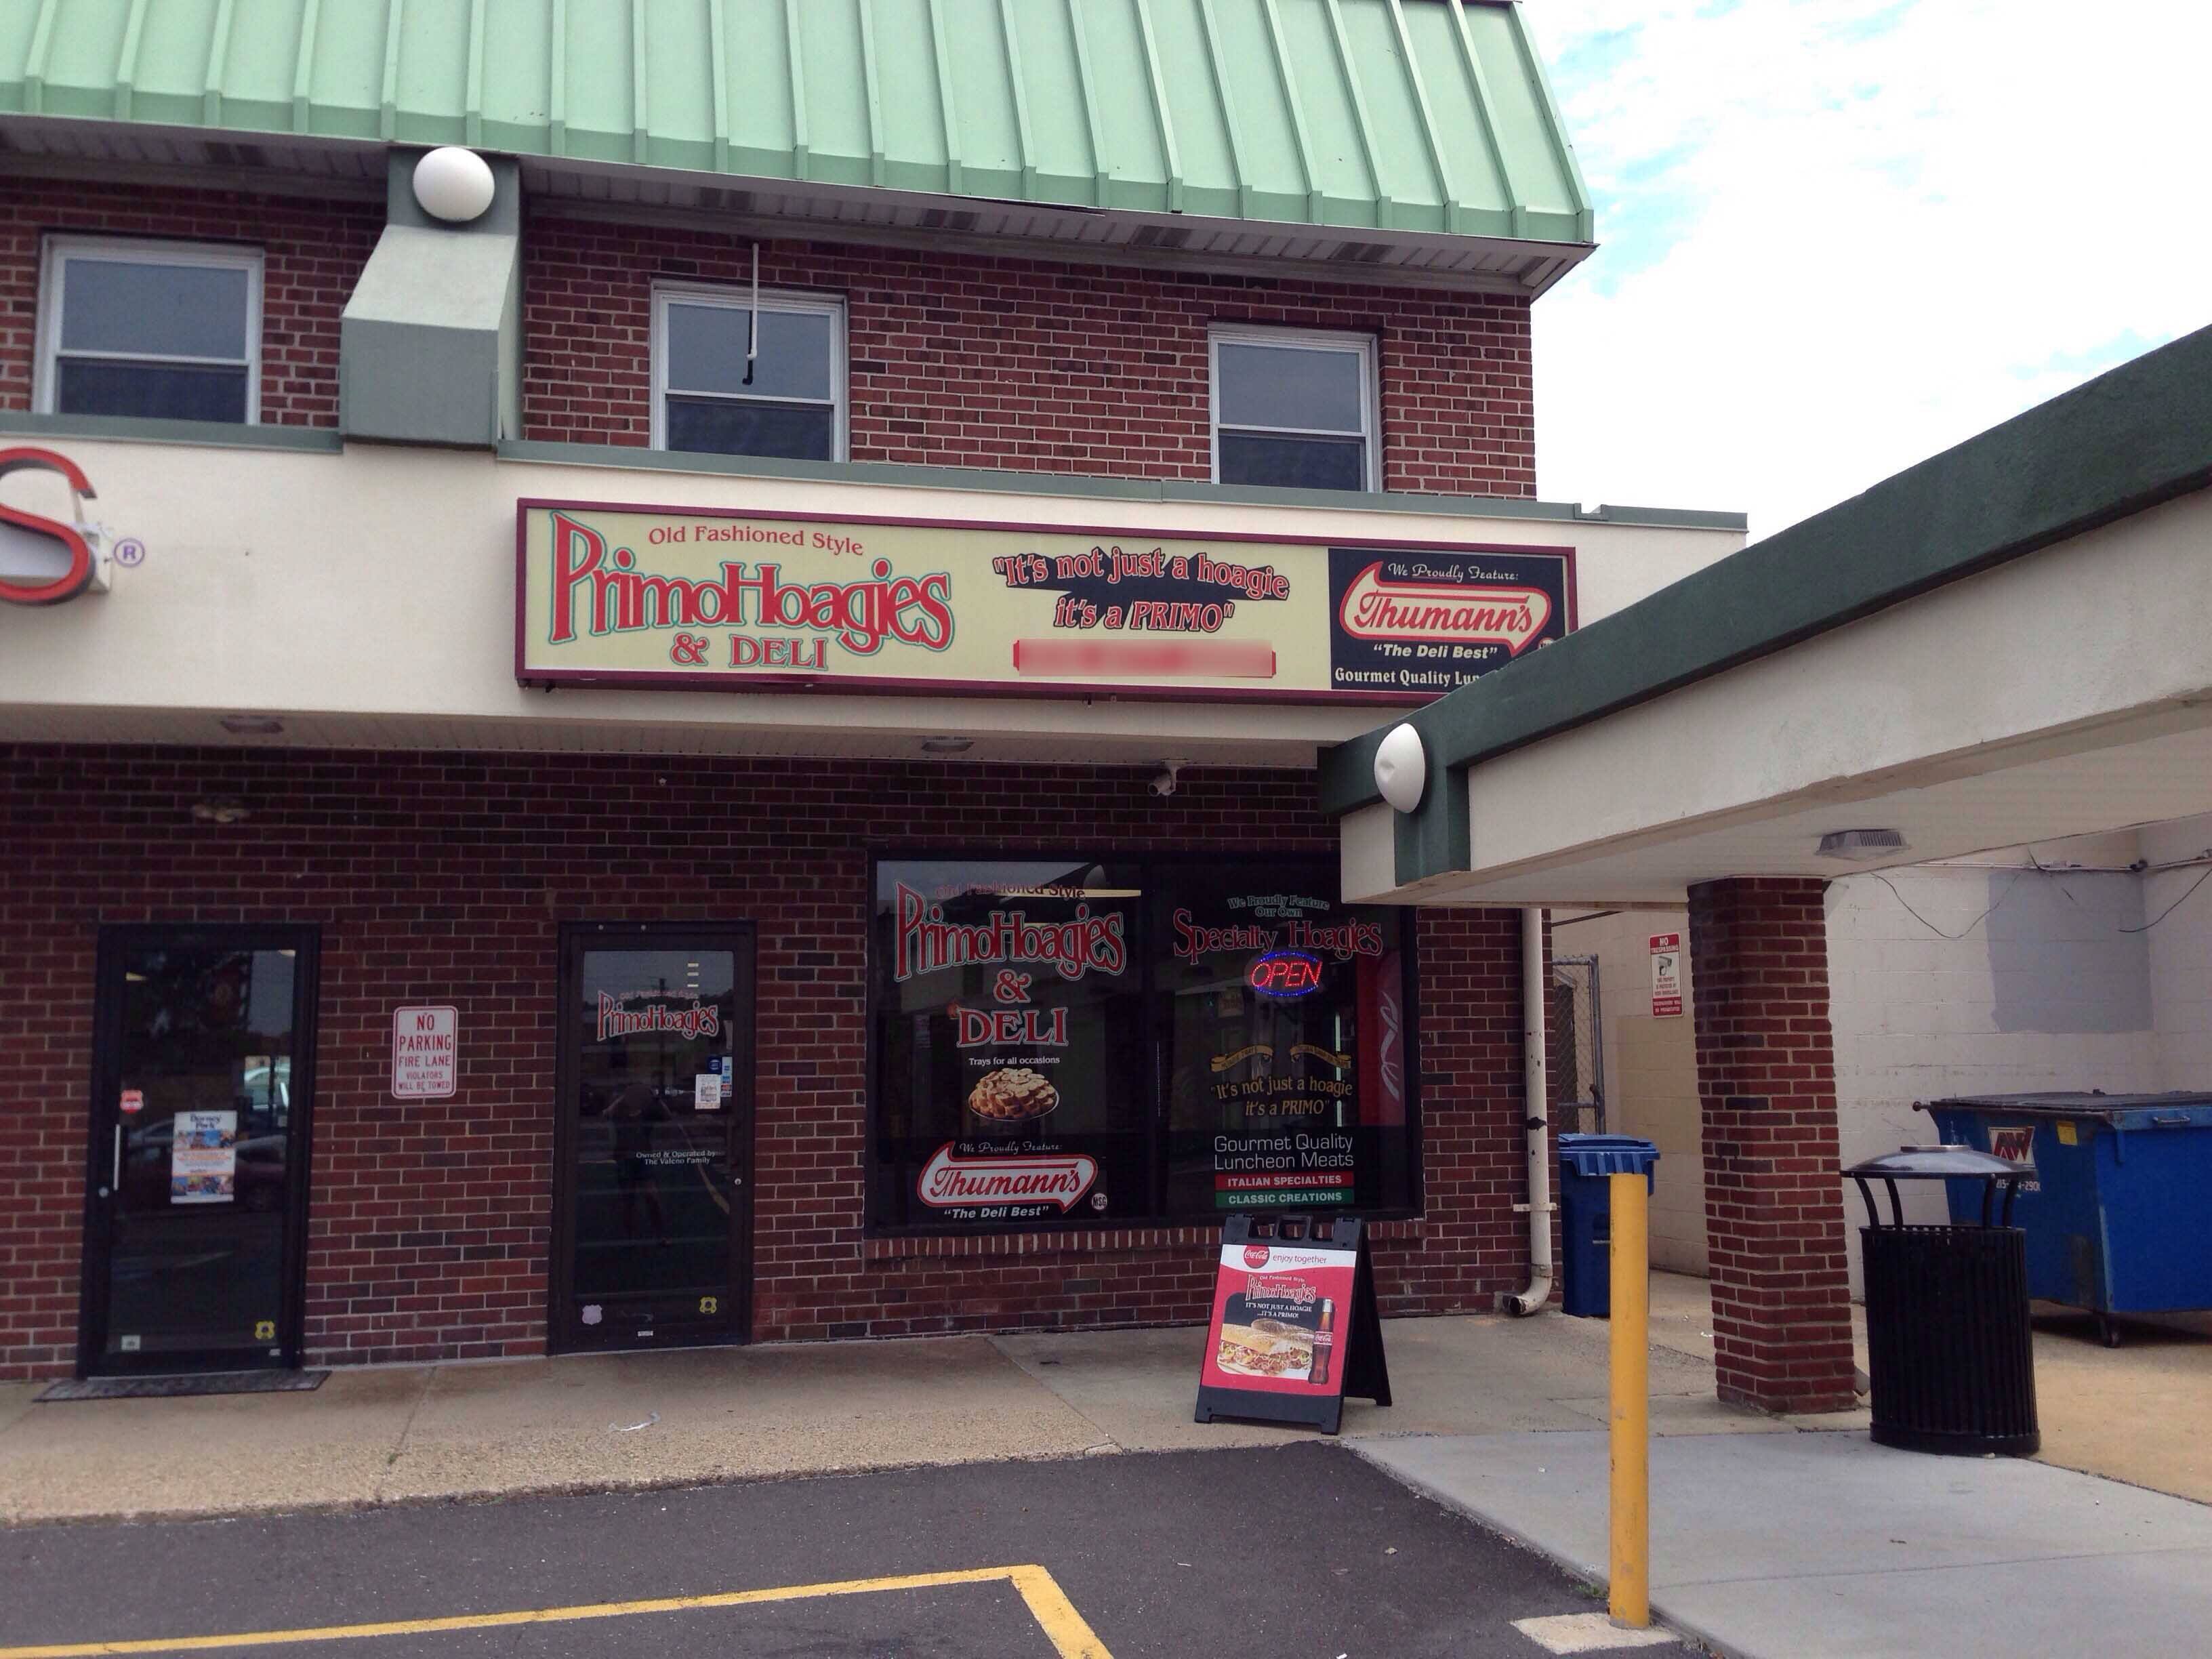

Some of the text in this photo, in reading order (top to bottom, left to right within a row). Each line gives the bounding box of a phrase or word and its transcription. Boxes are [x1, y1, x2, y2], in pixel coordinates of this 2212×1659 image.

[649, 525, 863, 556] Old Fashioned Style
[993, 546, 1290, 600] "It's not just a hoagie
[1388, 562, 1519, 583] We Proudly Feature:
[548, 511, 954, 656] PrimoHoagies
[1054, 597, 1235, 633] it's a PRIMO"
[1354, 591, 1532, 632] Thumann's
[670, 632, 829, 670] & DELI
[1374, 644, 1498, 659] "The Deli Best"
[1335, 668, 1395, 683] Gourmet
[1399, 670, 1450, 687] Quality
[1049, 884, 1086, 900] Style
[1227, 895, 1330, 910] We Proudly Feature
[1254, 906, 1303, 917] Our Own
[894, 881, 1126, 982] PrimoHoagies
[1173, 908, 1382, 965] Specialty Hoagies
[1659, 937, 1669, 945] NO
[1251, 960, 1322, 987] OPEN
[994, 968, 1031, 1003] &
[417, 1015, 434, 1030] NO
[596, 990, 719, 1042] PrimoHoagies
[956, 1006, 1069, 1048] DELI
[399, 1035, 451, 1051] PARKING
[398, 1055, 451, 1067] FIRE LANE
[969, 1058, 991, 1066] Trays
[1019, 1056, 1060, 1064] occasions
[1242, 1079, 1264, 1094] not
[1267, 1076, 1293, 1095] just
[1297, 1080, 1305, 1090] a
[1310, 1076, 1353, 1097] hoagie
[1246, 1101, 1265, 1116] it's
[1269, 1104, 1277, 1115] a
[960, 1143, 975, 1152] We
[978, 1141, 1019, 1155] Proudly
[1214, 1133, 1353, 1153] Gourmet Quality
[1214, 1153, 1353, 1170] Luncheon Meats
[930, 1162, 1081, 1197] Thumann's
[1228, 1175, 1342, 1187] ITALIAN SPECIALTIES
[1229, 1192, 1342, 1204] CLASSIC CREATIONS
[945, 1206, 1048, 1218] "The Deli Best"
[1273, 1254, 1292, 1263] enjoy
[1295, 1256, 1327, 1265] together
[1245, 1274, 1316, 1305] PrimoHoagies
